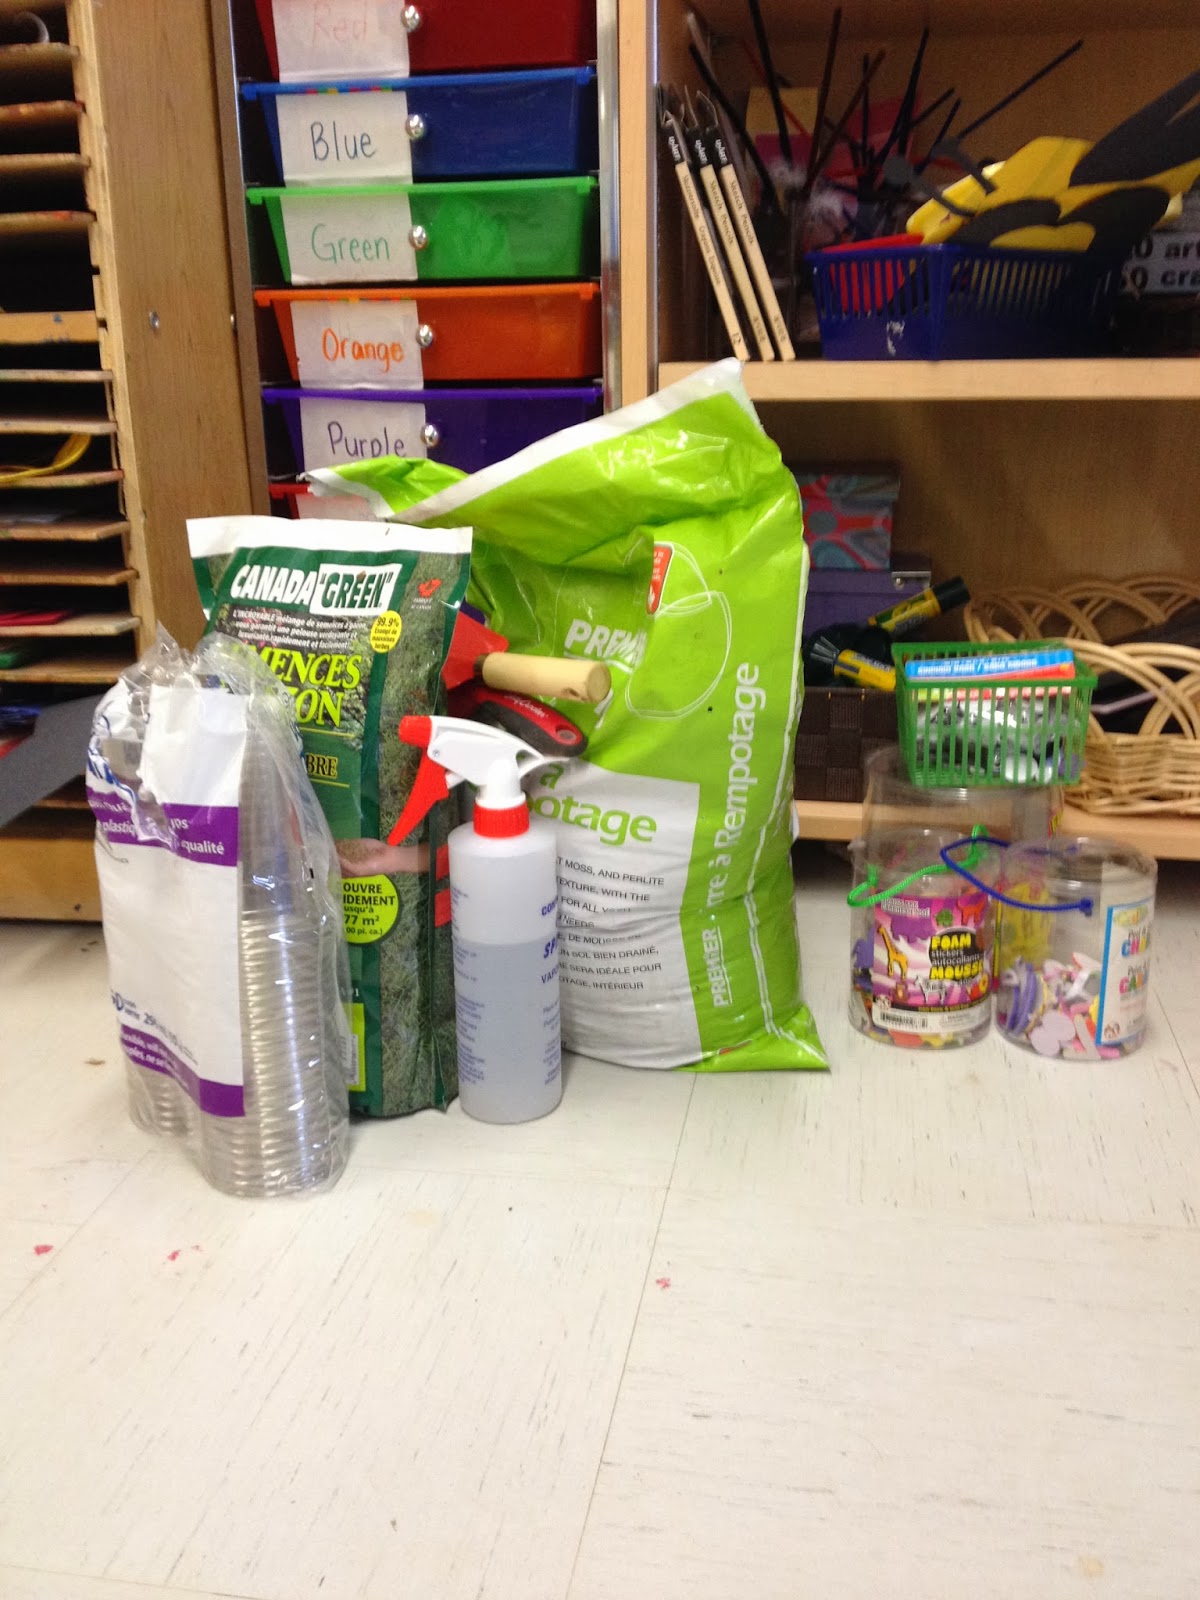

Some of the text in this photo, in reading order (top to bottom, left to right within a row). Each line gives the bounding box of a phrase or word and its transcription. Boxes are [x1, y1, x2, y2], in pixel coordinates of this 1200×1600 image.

[311, 1, 368, 45] Red
[310, 120, 376, 163] Blue
[710, 180, 734, 245] Sketch Pencils
[730, 180, 755, 245] Sketch Pencils
[311, 223, 390, 264] Green
[322, 328, 405, 373] Orange
[326, 421, 407, 459] Purple
[230, 564, 318, 606] CANADA
[306, 618, 316, 627] de
[377, 617, 400, 627] 99.9%
[277, 626, 291, 634] une
[290, 627, 318, 638] pelouse
[714, 662, 767, 849] Rempotage
[306, 753, 339, 779] BRE
[181, 840, 225, 855] qualité
[708, 853, 732, 868] à
[565, 859, 595, 876] MOSS,
[598, 869, 620, 879] AND
[622, 873, 665, 886] PERLITE
[342, 882, 383, 894] OUVRE
[601, 887, 627, 899] WITH
[630, 892, 650, 901] THE
[342, 894, 396, 906] IDEMENT
[561, 895, 580, 908] FOR
[582, 902, 599, 913] ALL
[344, 914, 358, 925] 77
[562, 914, 595, 927] NEEDS
[568, 933, 581, 942] DE
[931, 932, 972, 951] FOAM
[572, 951, 591, 959] SOL
[594, 951, 616, 959] BIEN
[618, 945, 659, 959] DRAINÉ,
[931, 949, 964, 959] stickers
[570, 964, 595, 974] SERA
[596, 964, 630, 975] IDÉALE
[632, 962, 662, 975] POUR
[702, 927, 730, 1007] PREMIER
[593, 981, 644, 990] INTÉRIEUR
